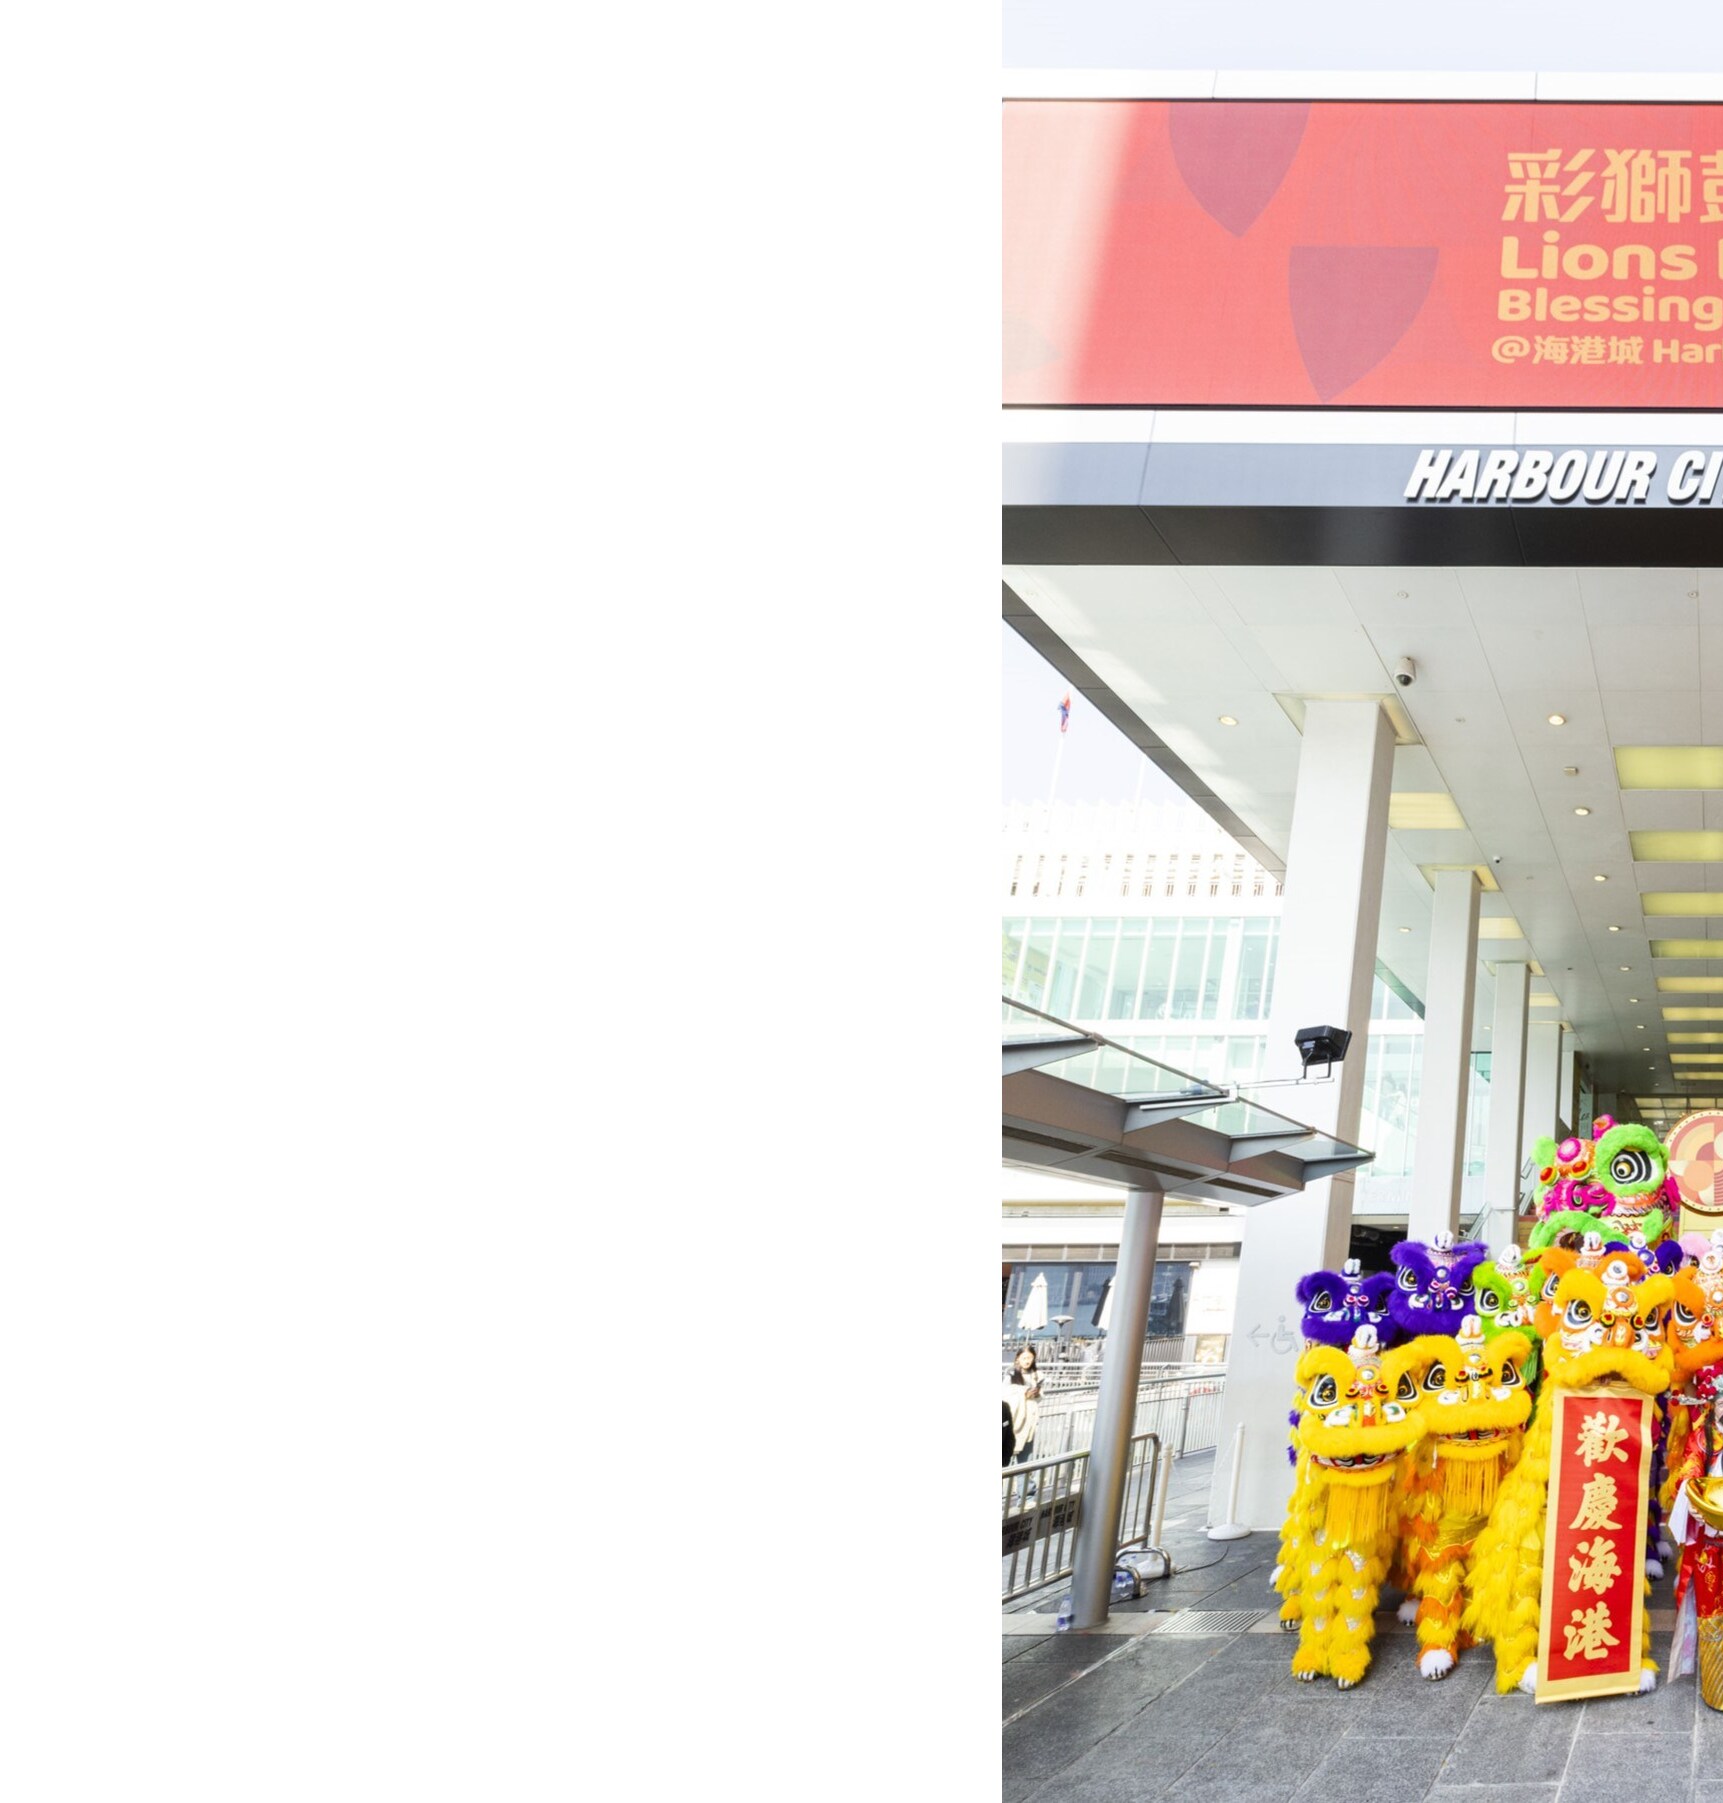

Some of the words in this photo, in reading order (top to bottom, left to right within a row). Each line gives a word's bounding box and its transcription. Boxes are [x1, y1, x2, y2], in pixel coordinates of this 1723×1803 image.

[1500, 230, 1698, 281] Lions
[1403, 449, 1659, 504] HARBOUR
[1562, 1411, 1630, 1660] 歡慶海港
